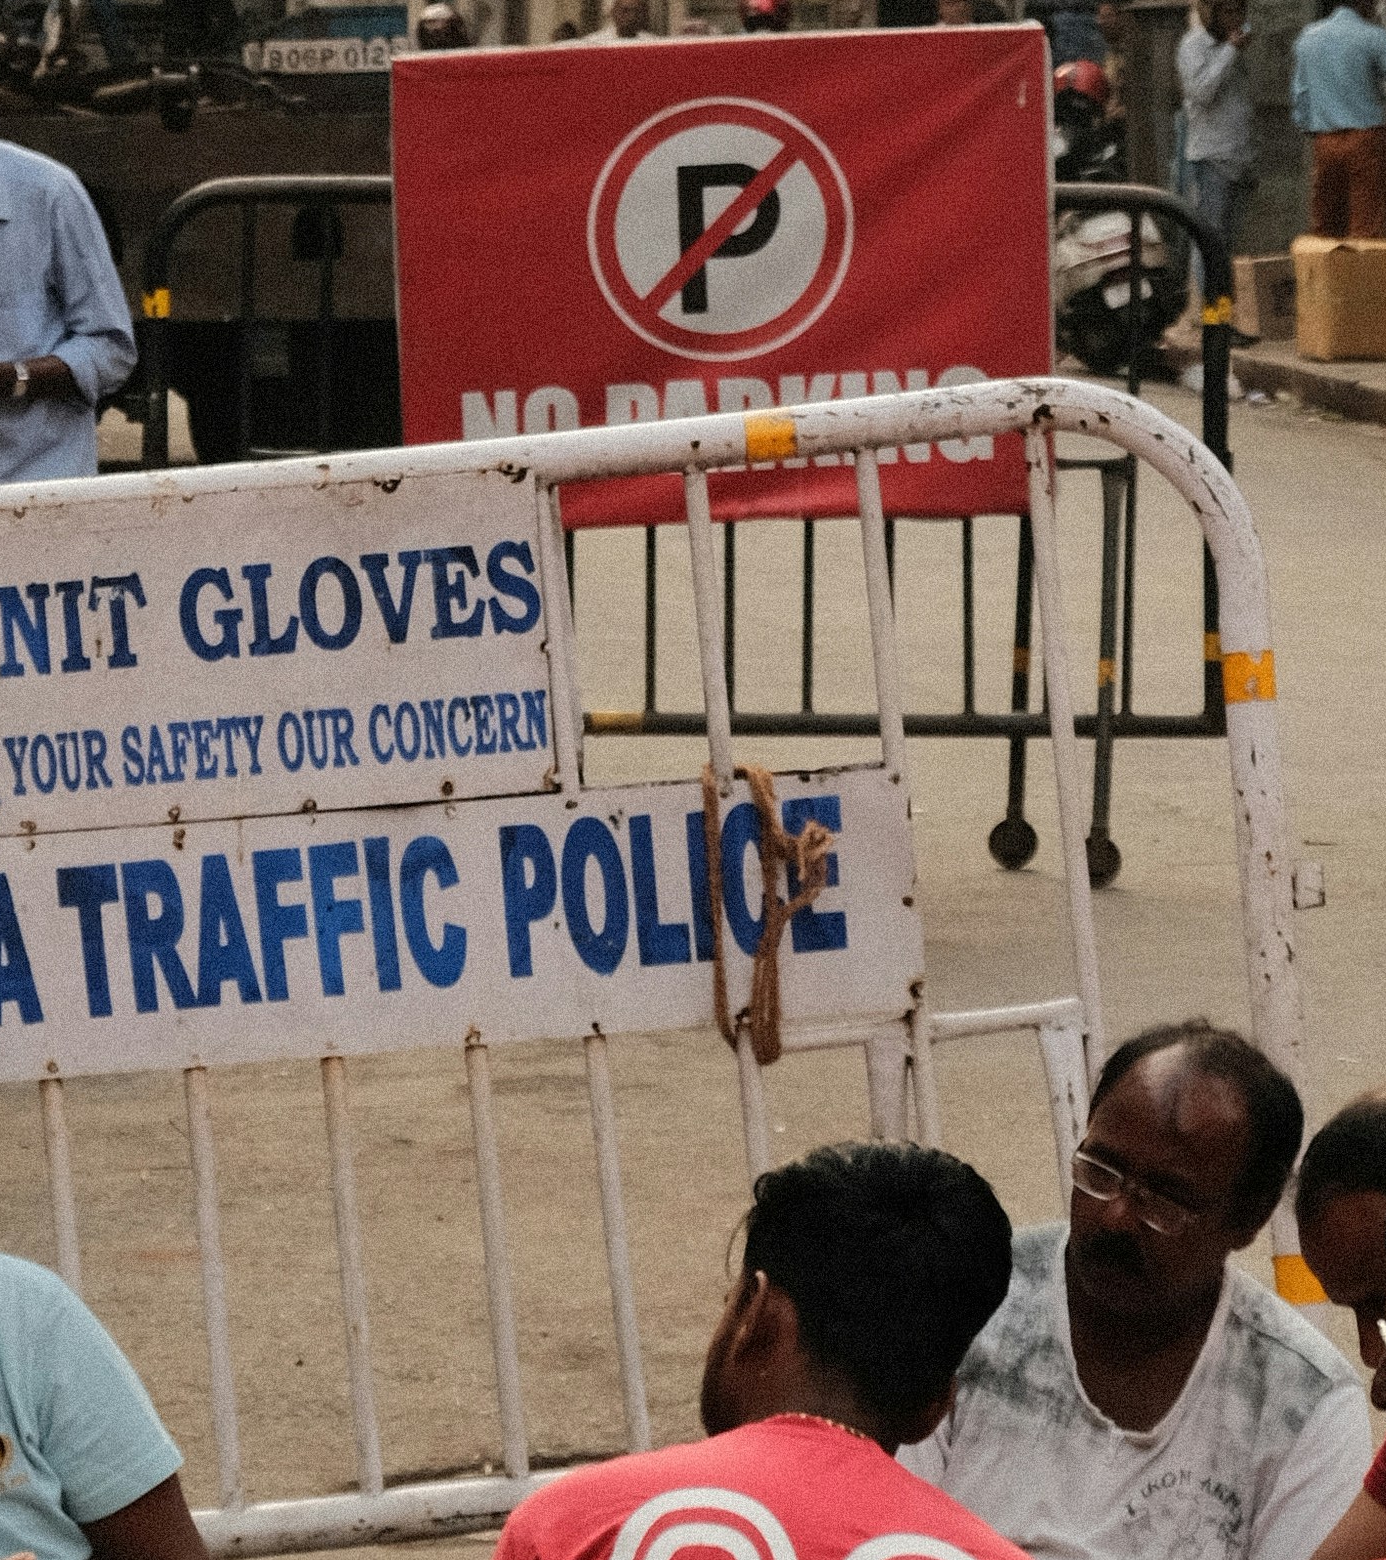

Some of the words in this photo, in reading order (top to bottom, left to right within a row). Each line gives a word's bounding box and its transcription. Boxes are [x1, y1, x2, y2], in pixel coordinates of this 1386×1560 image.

[178, 540, 542, 663] GLOVES
[3, 728, 113, 797] YOUR
[120, 713, 265, 787] SAFETY
[277, 708, 360, 773] OUR
[368, 689, 548, 764] CONCERN
[56, 835, 468, 1018] TRAFFIC
[499, 794, 849, 978] POLICE
